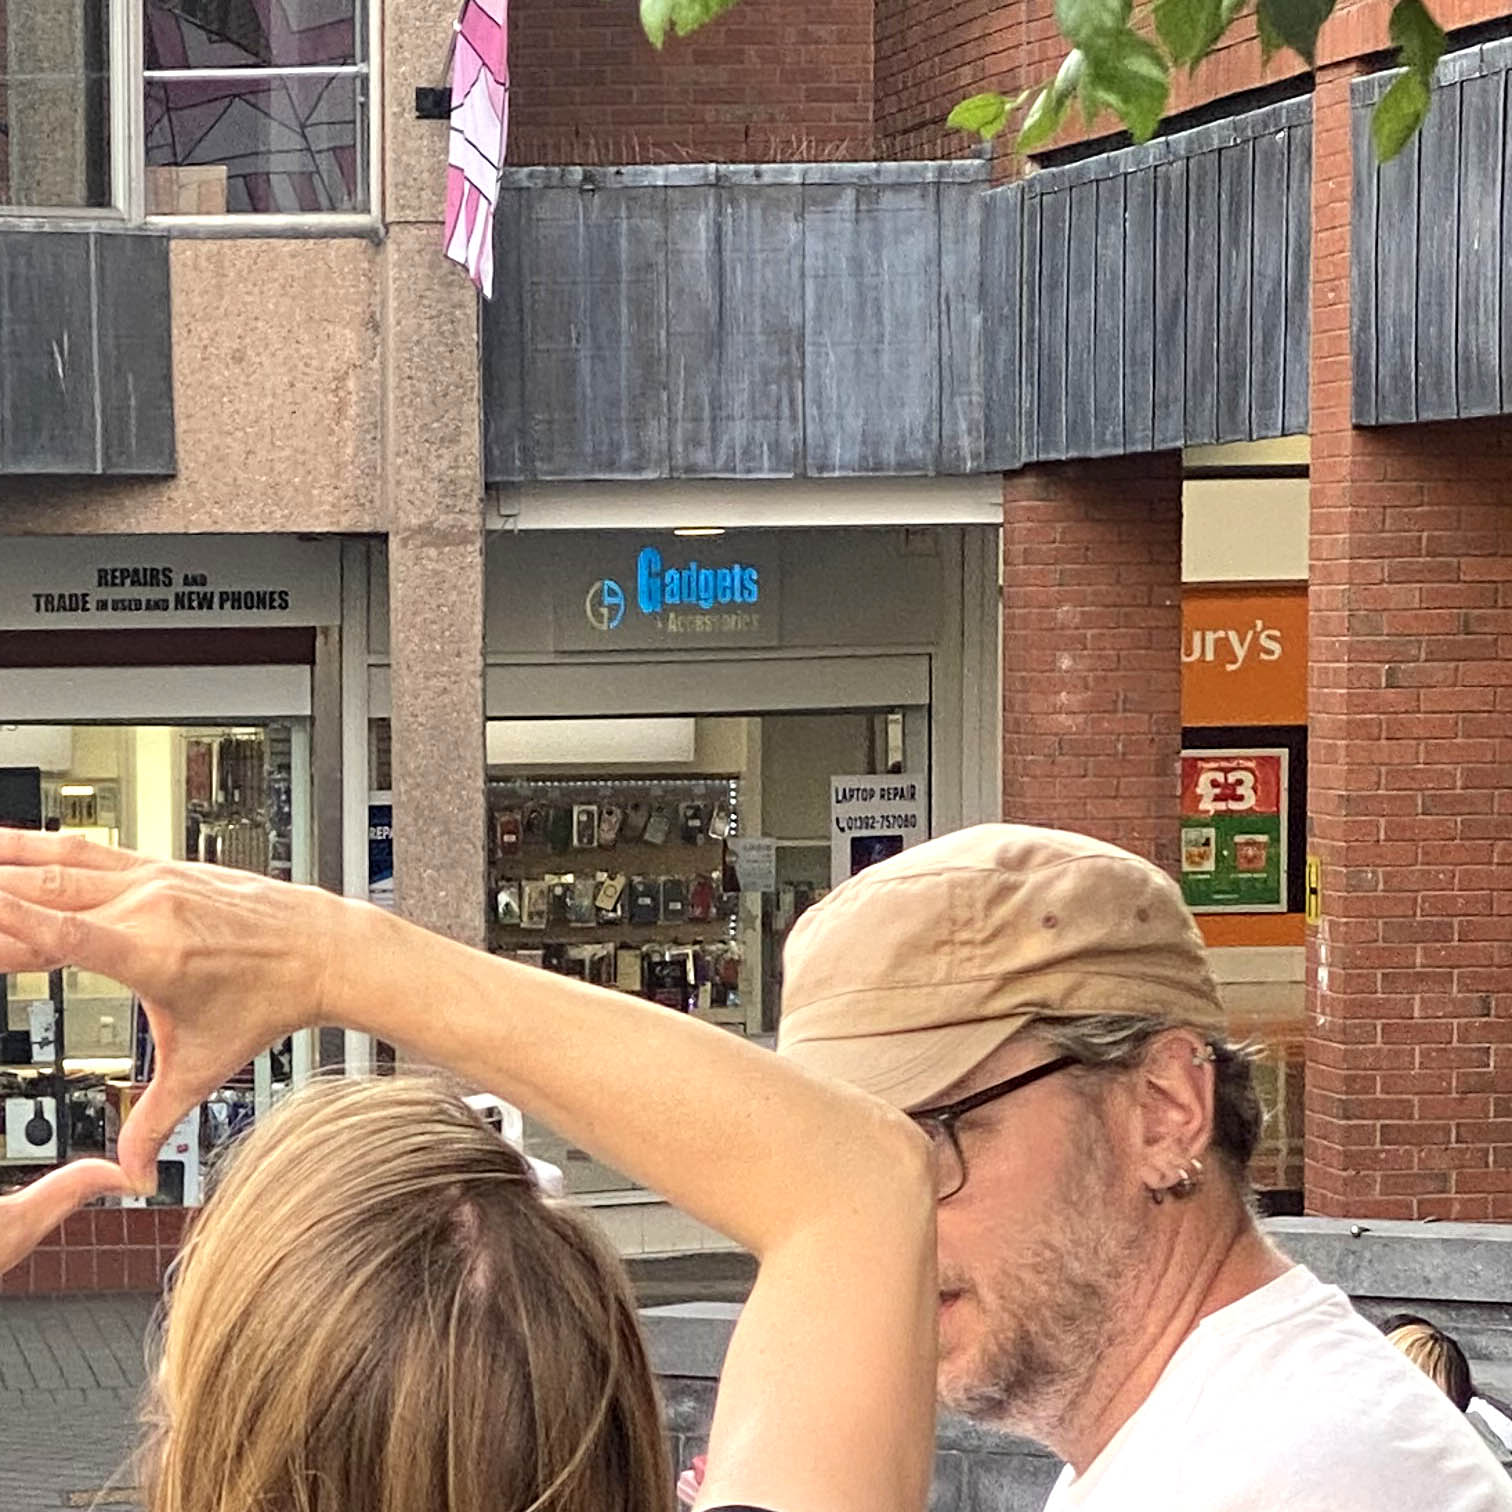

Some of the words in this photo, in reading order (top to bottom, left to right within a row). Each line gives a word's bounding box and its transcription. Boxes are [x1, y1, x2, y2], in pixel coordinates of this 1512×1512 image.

[96, 567, 173, 588] REPAIRS
[183, 573, 207, 587] AND
[637, 546, 759, 613] Gadgets
[33, 592, 90, 612] TRADE
[96, 598, 109, 611] IN
[111, 598, 143, 611] USED
[145, 598, 170, 611] AND
[174, 591, 214, 611] NEW
[219, 590, 289, 610] PHONES
[1181, 619, 1283, 672] ury's
[835, 786, 876, 803] LAPTOP
[880, 784, 917, 801] REPAIR
[1196, 769, 1257, 813] £3
